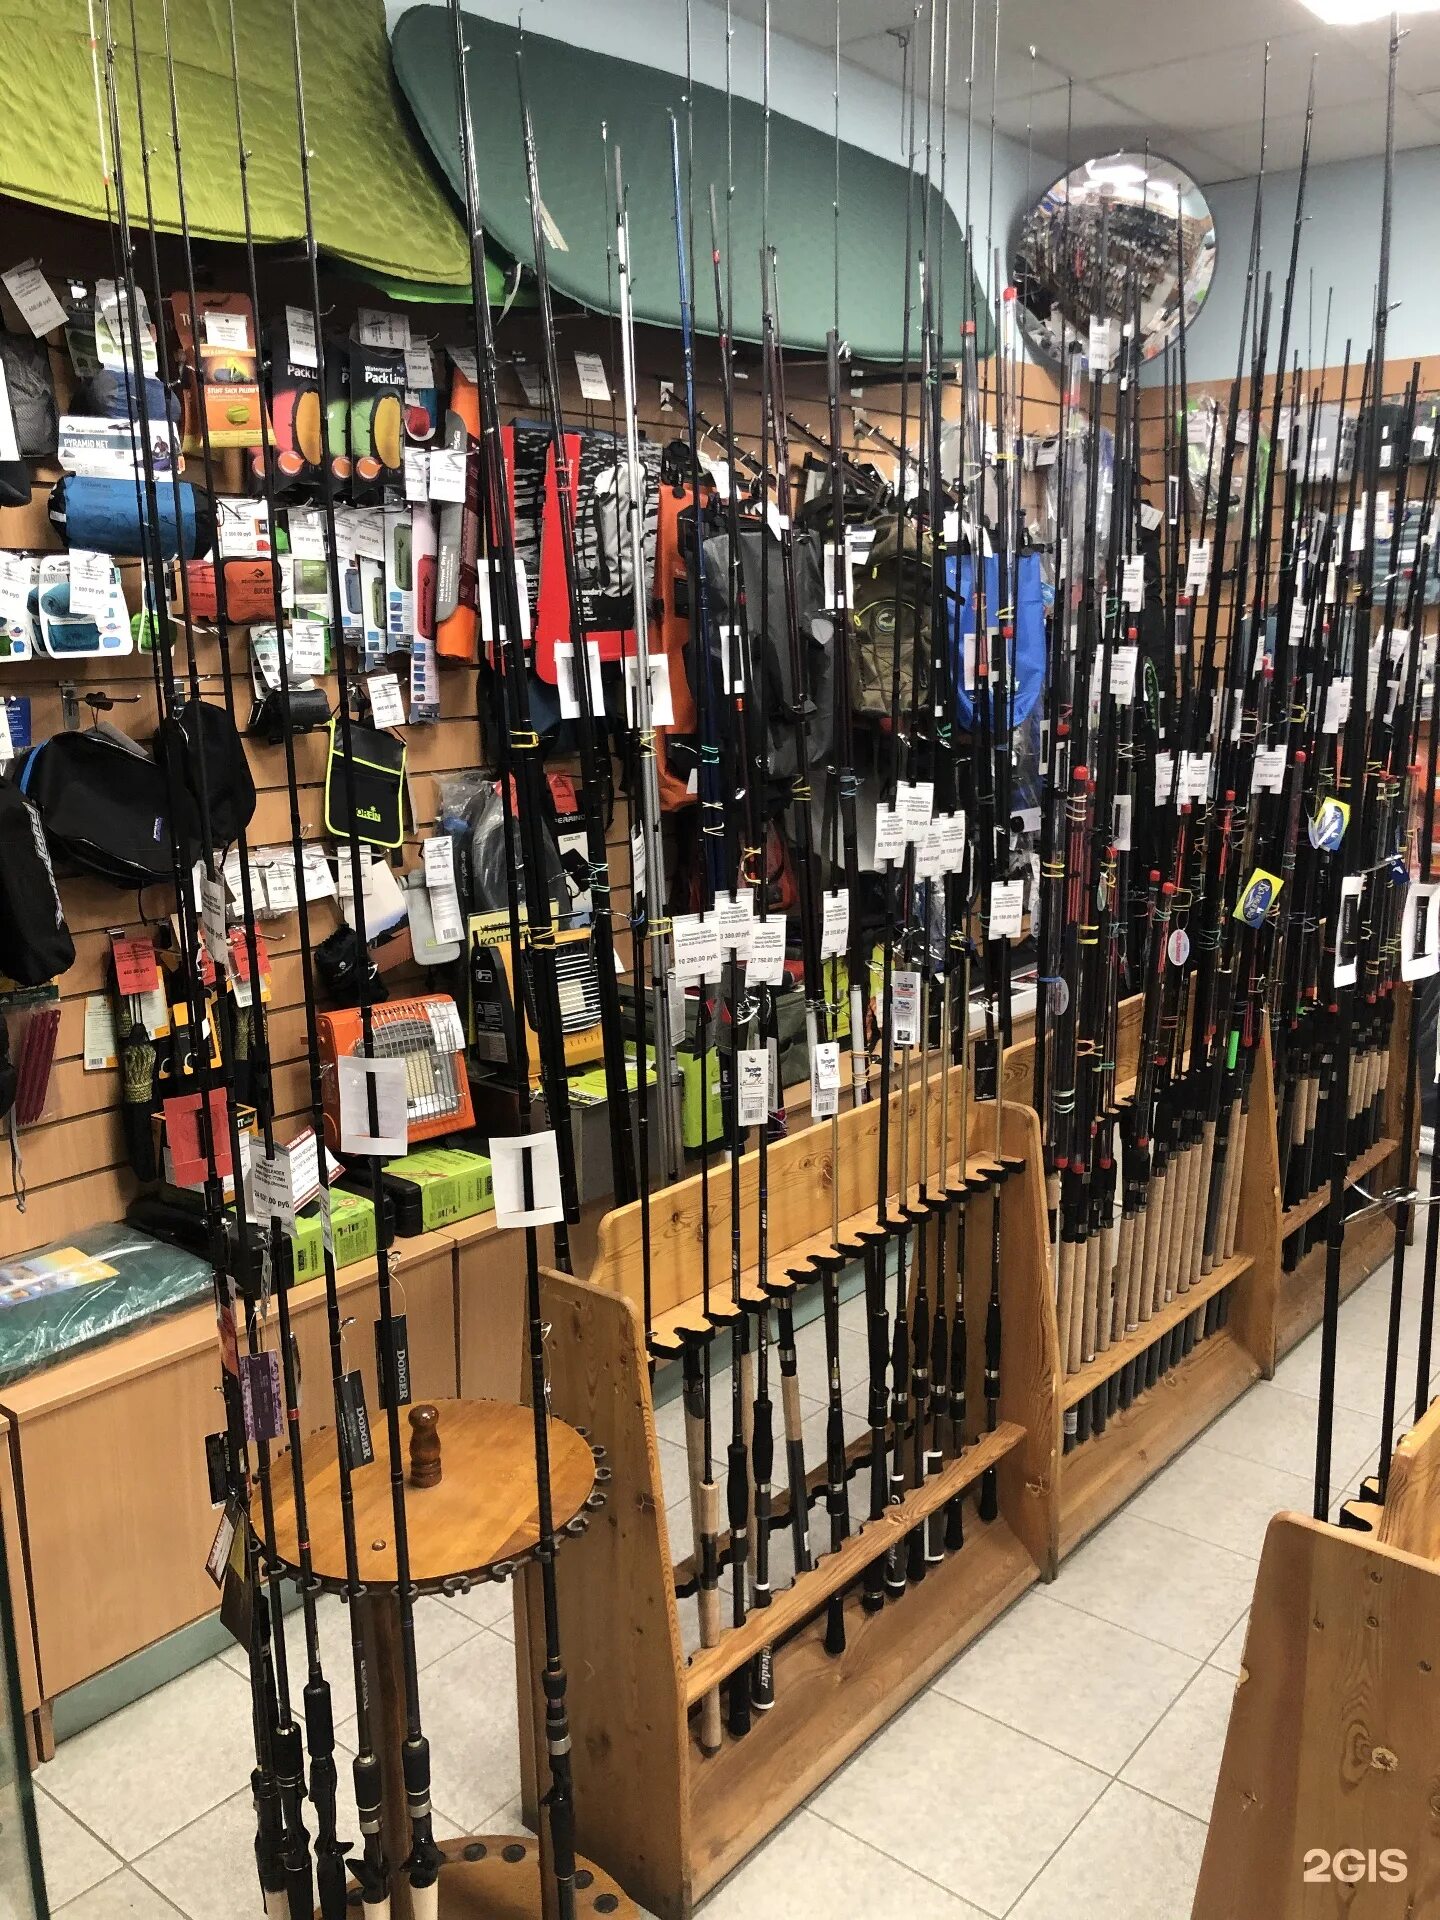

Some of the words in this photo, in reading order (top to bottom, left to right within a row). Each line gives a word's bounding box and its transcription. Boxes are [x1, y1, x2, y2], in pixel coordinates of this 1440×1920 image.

[287, 366, 310, 378] Pack
[365, 371, 389, 384] Pack
[744, 1066, 762, 1074] Tangle
[277, 1199, 292, 1209] руб.
[396, 1349, 409, 1401] DODGER
[356, 1407, 372, 1459] DODGER
